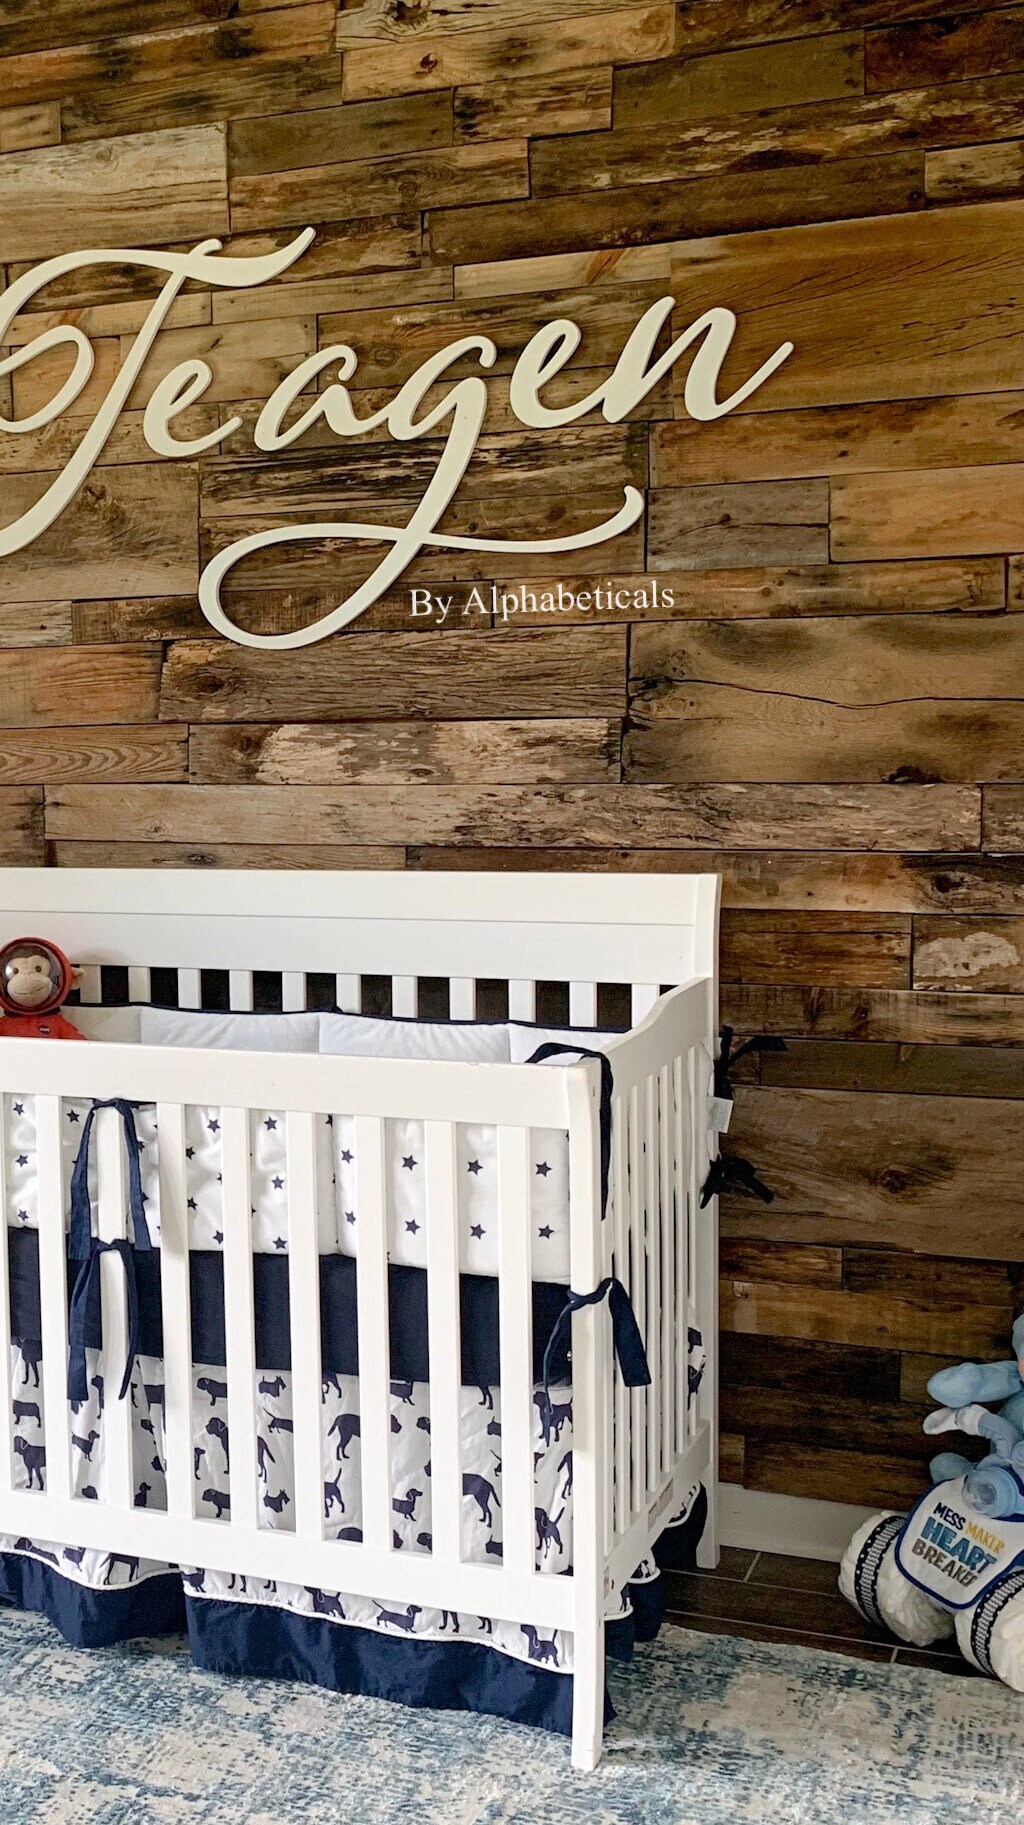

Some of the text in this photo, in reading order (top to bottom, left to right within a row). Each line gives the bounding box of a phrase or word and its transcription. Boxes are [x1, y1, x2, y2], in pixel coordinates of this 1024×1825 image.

[920, 1516, 997, 1574] HEART
[933, 1502, 1005, 1554] MESS MAKER
